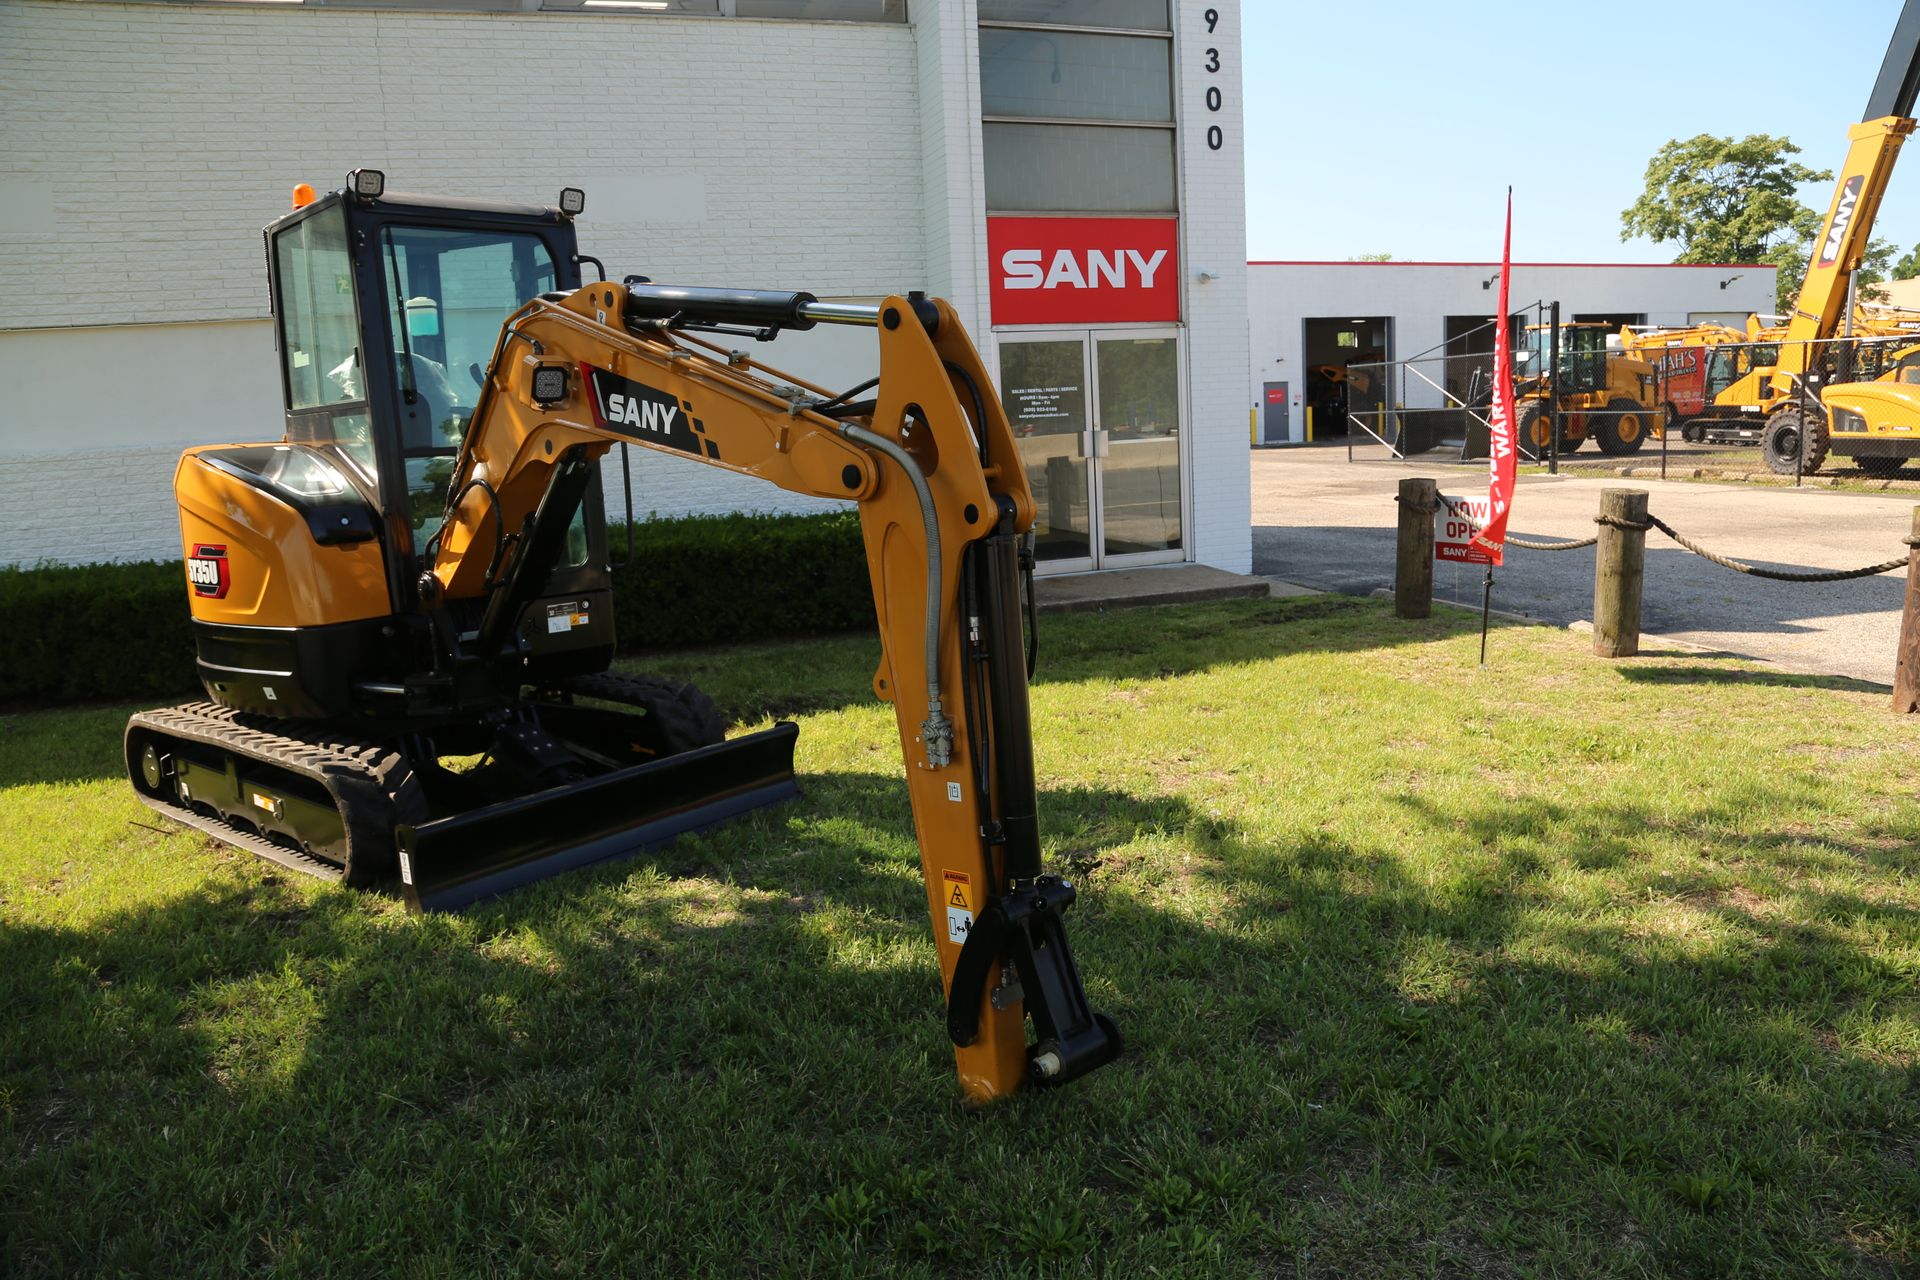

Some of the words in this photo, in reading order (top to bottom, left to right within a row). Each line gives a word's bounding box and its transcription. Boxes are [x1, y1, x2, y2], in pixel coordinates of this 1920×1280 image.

[1204, 8, 1223, 151] 9300
[1823, 186, 1857, 260] SANY
[1001, 249, 1168, 289] SANY
[608, 393, 677, 434] SANY
[1448, 501, 1488, 518] NOW
[1446, 521, 1479, 539] OPE
[1443, 547, 1467, 557] SANY
